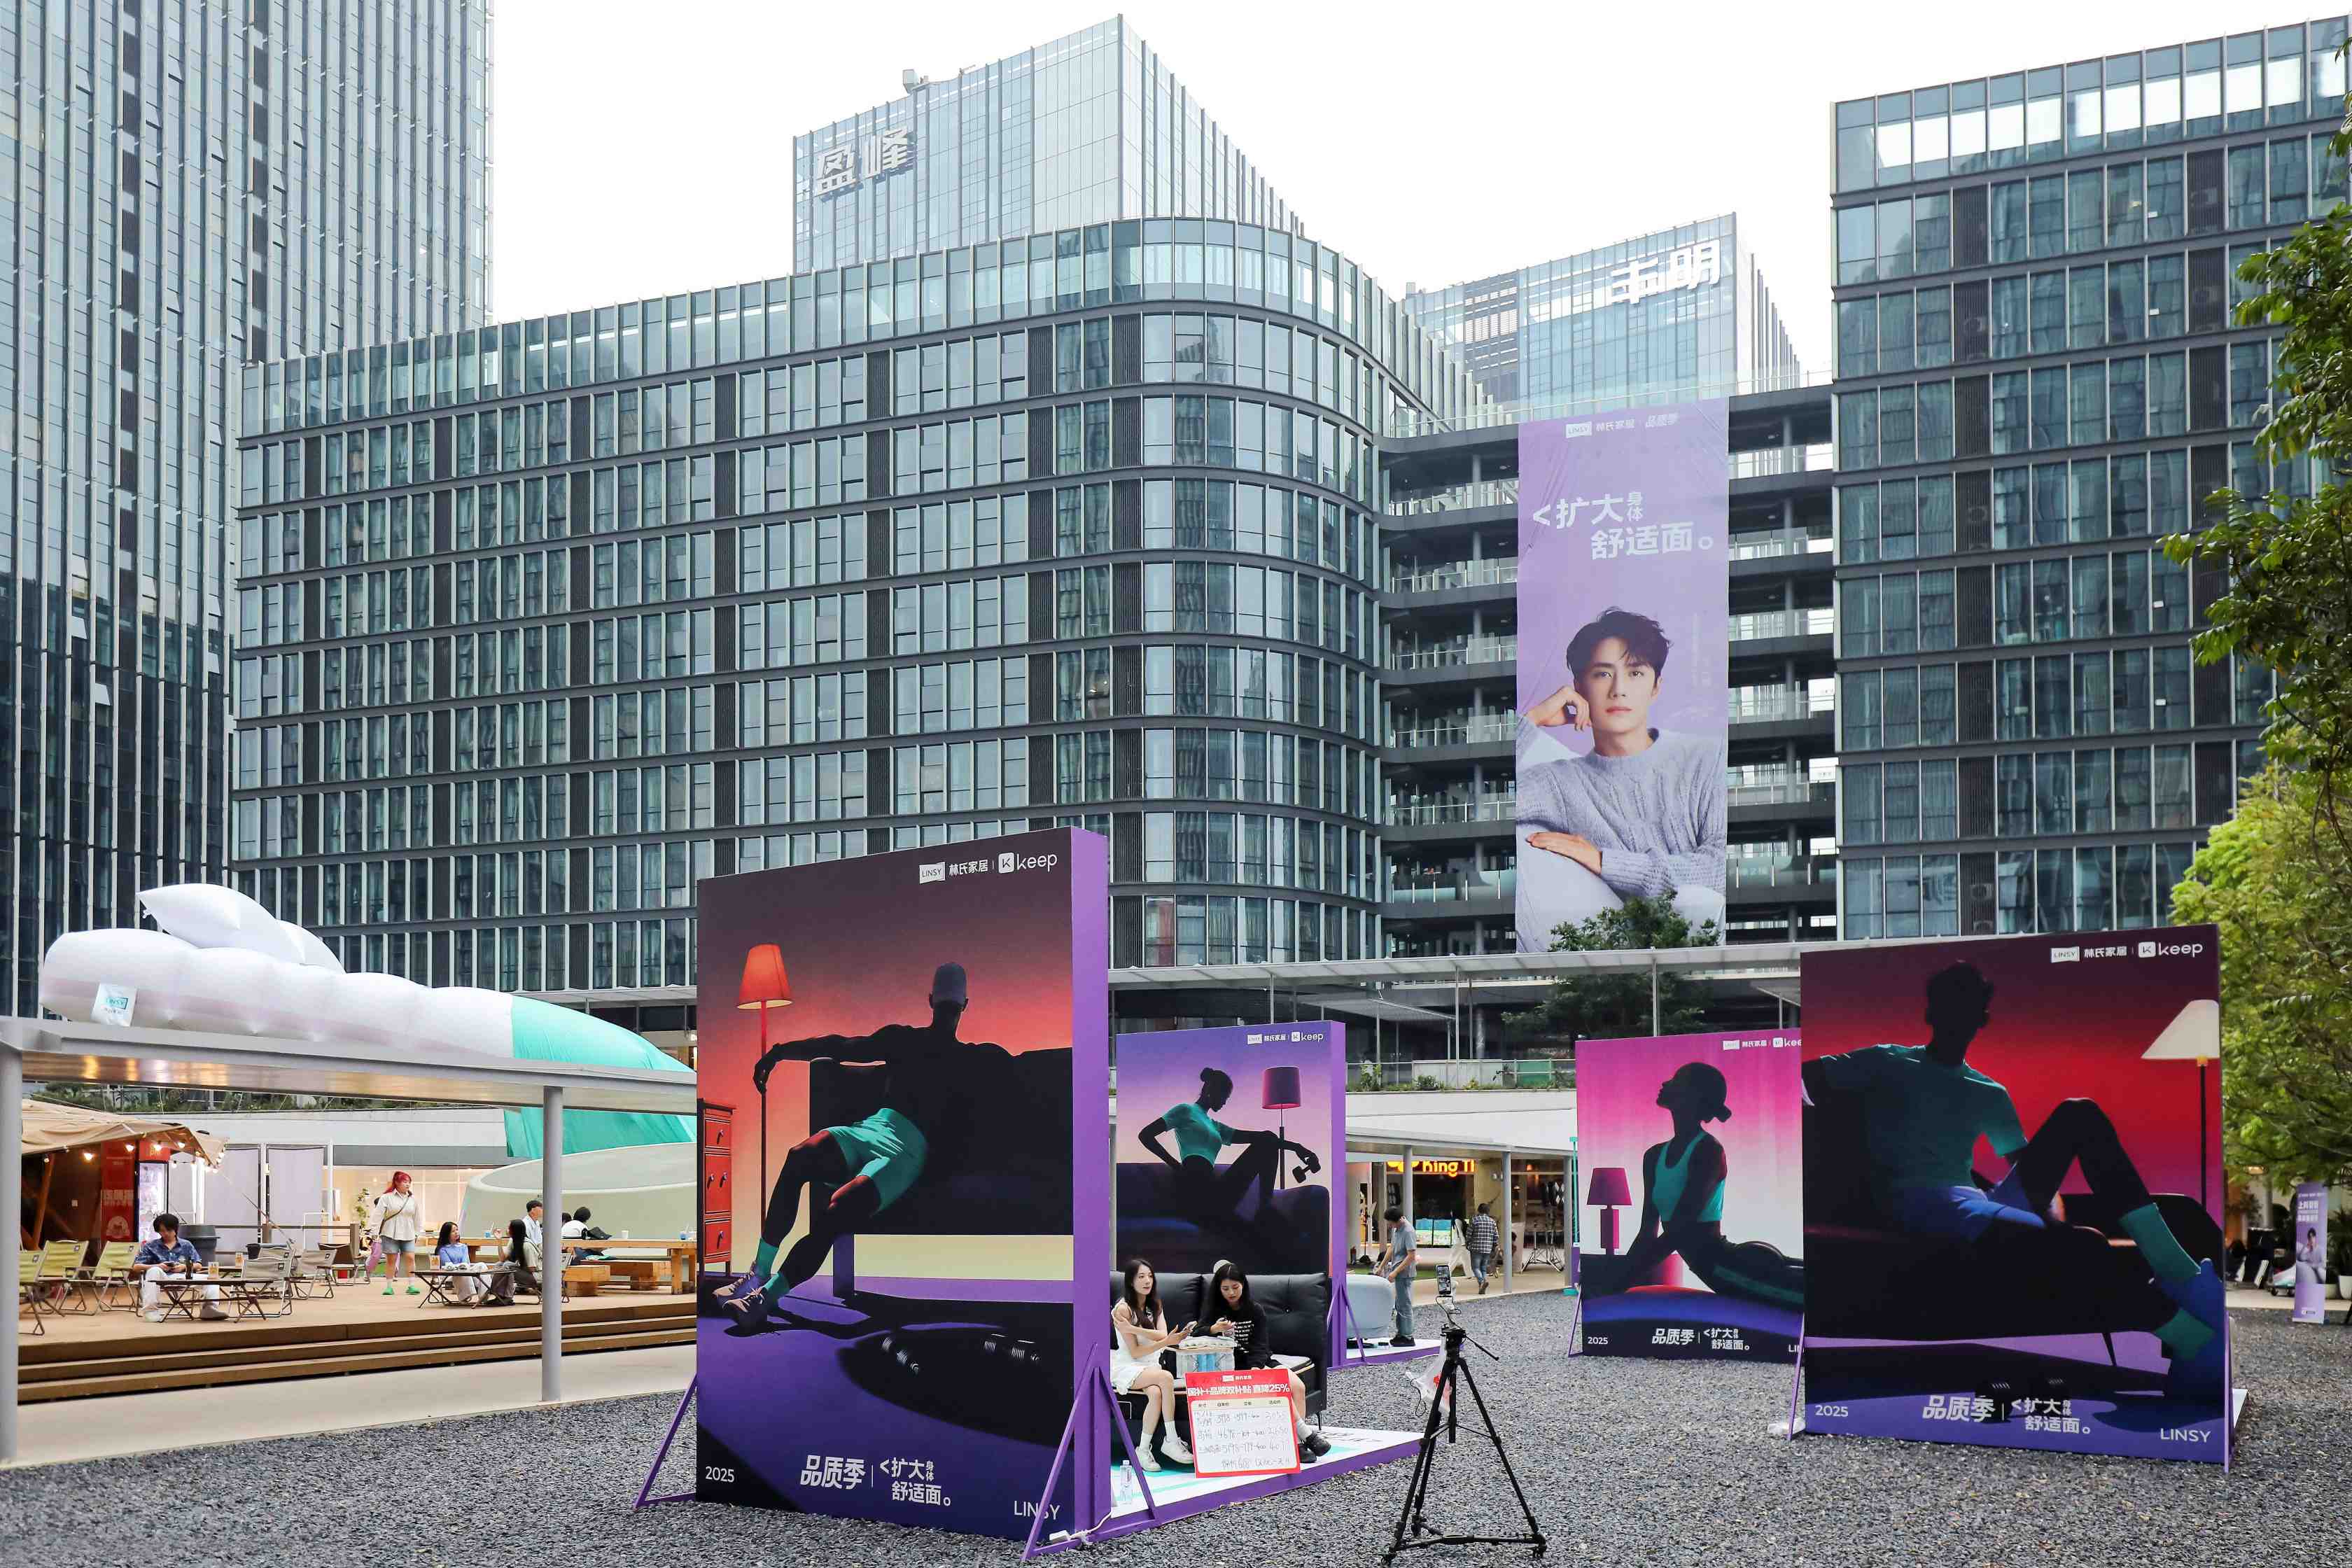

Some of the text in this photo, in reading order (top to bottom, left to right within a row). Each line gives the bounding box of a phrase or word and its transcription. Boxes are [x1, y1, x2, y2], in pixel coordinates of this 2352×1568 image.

[814, 127, 909, 197] 盈峰
[948, 859, 988, 876] 林氏家居
[1016, 853, 1058, 872] keep
[2084, 946, 2127, 958] 林氏家居
[2159, 942, 2204, 958] keep
[1301, 1032, 1324, 1042] keep
[1588, 1336, 1609, 1345] 2025
[1652, 1328, 1695, 1345] 品质季
[1814, 1405, 1849, 1418] 2025
[1922, 1394, 1996, 1423] 品质季
[2160, 1427, 2211, 1443] LINSY
[706, 1465, 735, 1483] 2025
[799, 1455, 866, 1490] 品质季
